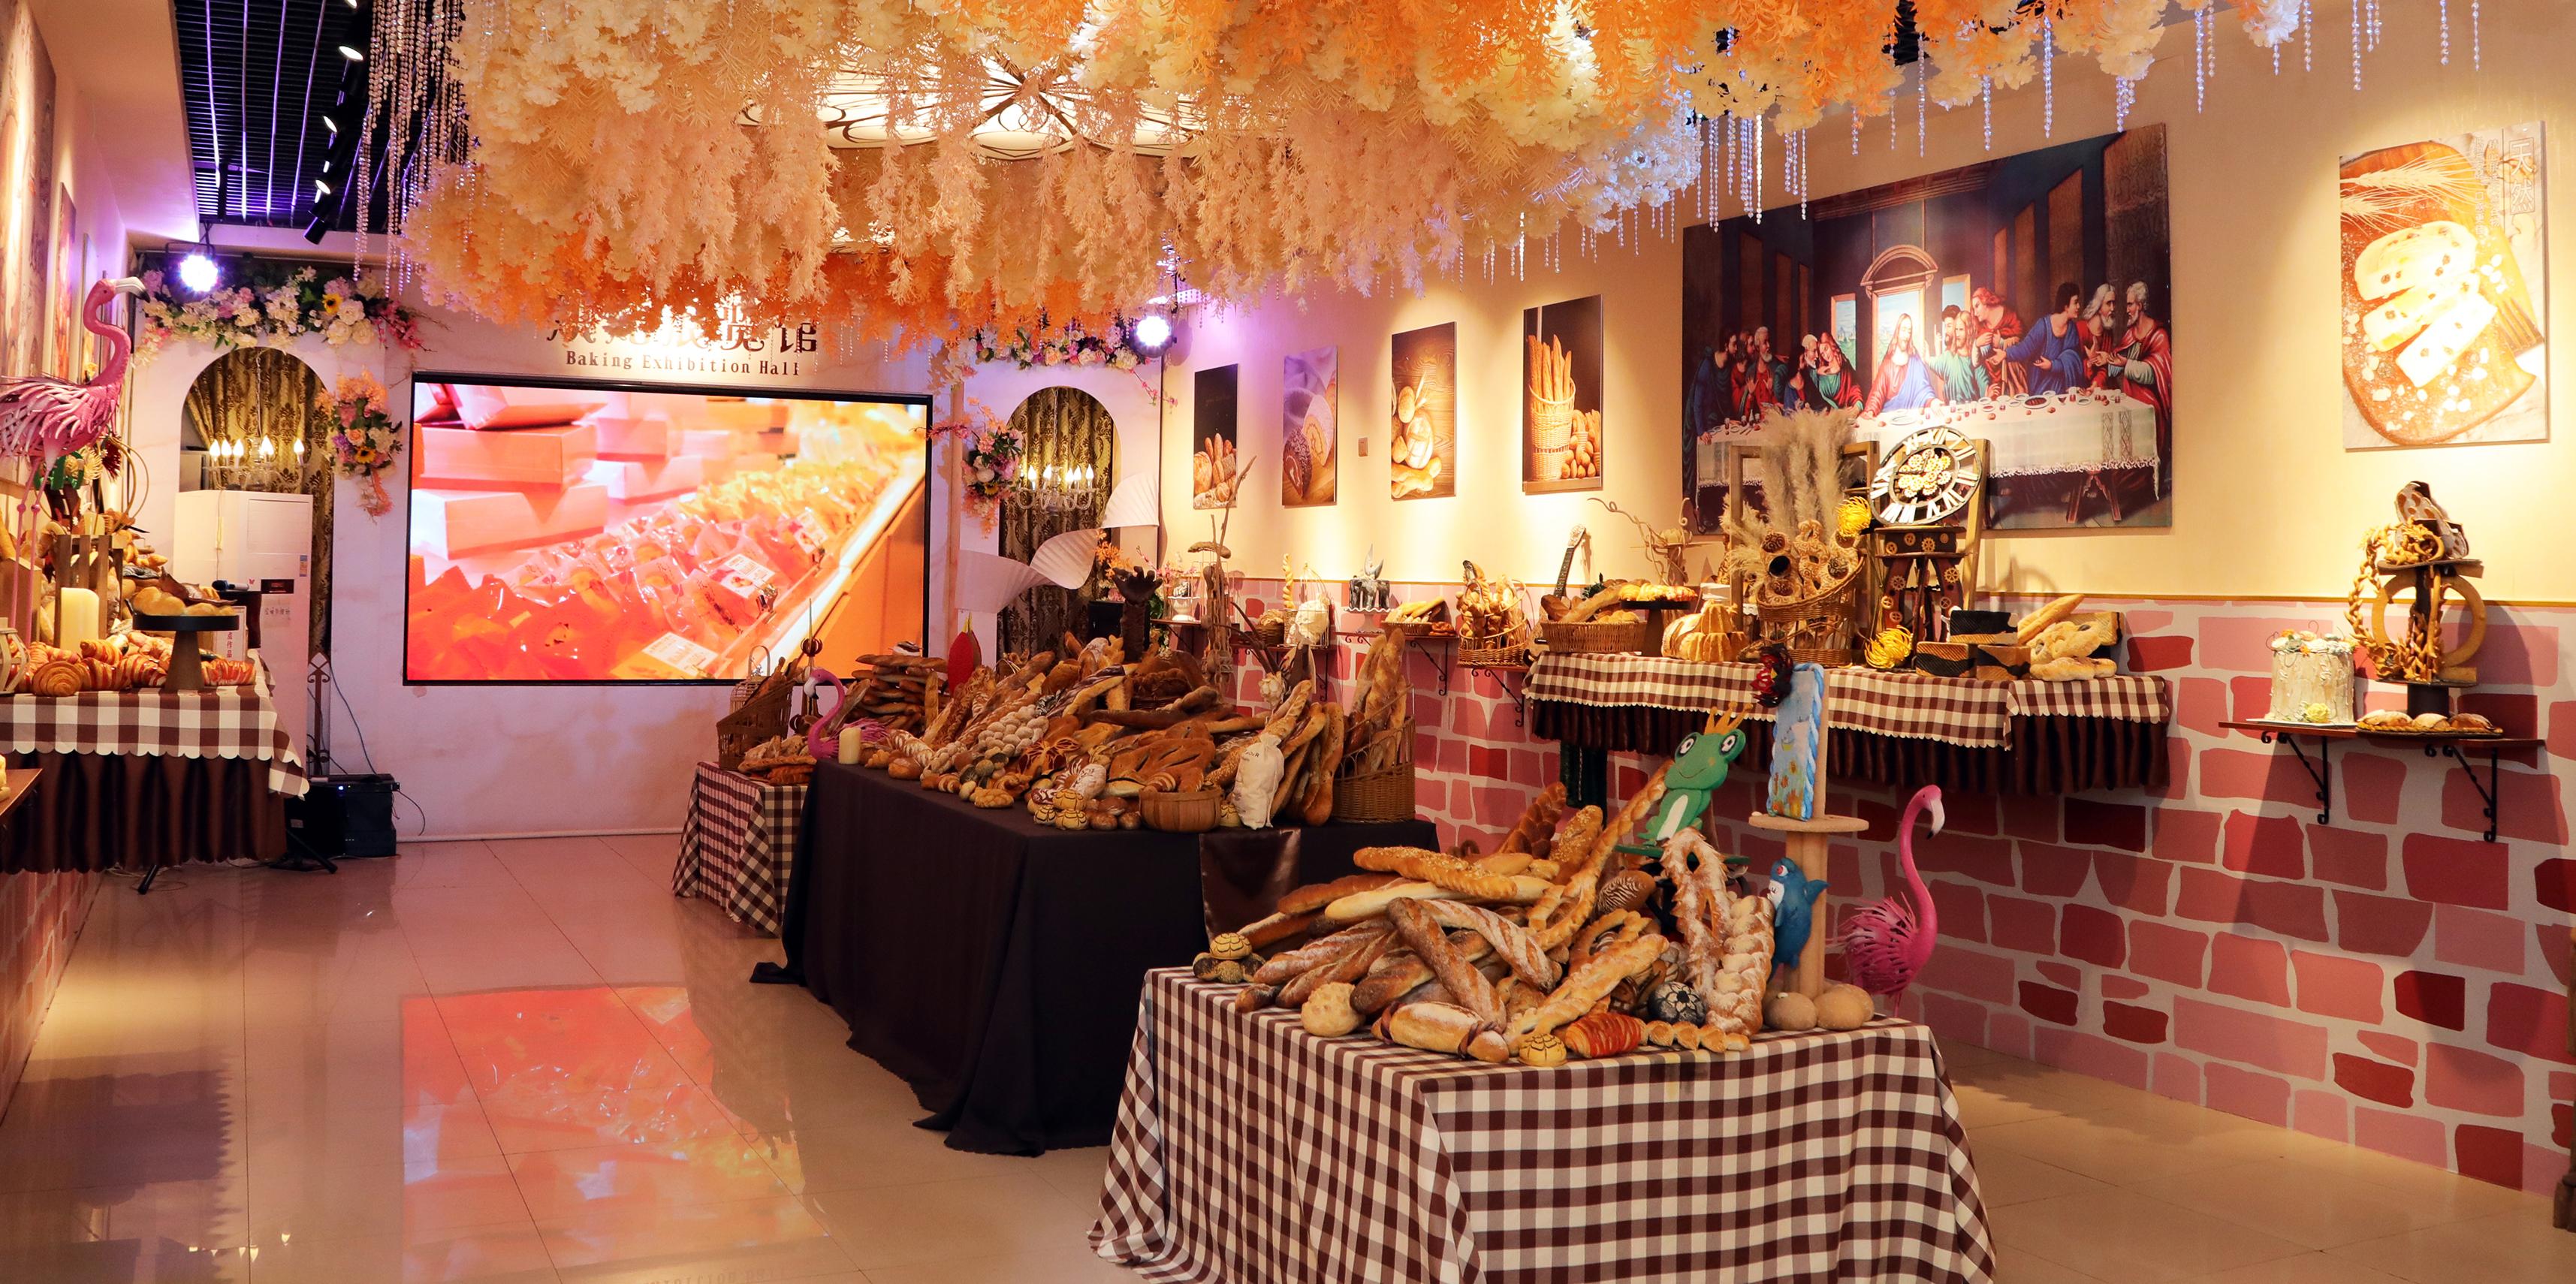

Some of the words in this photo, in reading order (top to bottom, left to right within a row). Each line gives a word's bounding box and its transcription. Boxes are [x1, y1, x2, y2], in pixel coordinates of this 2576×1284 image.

[2511, 142, 2534, 212] 天然
[566, 350, 632, 369] Baking
[642, 354, 751, 374] Exhibition
[759, 360, 800, 376] Hall
